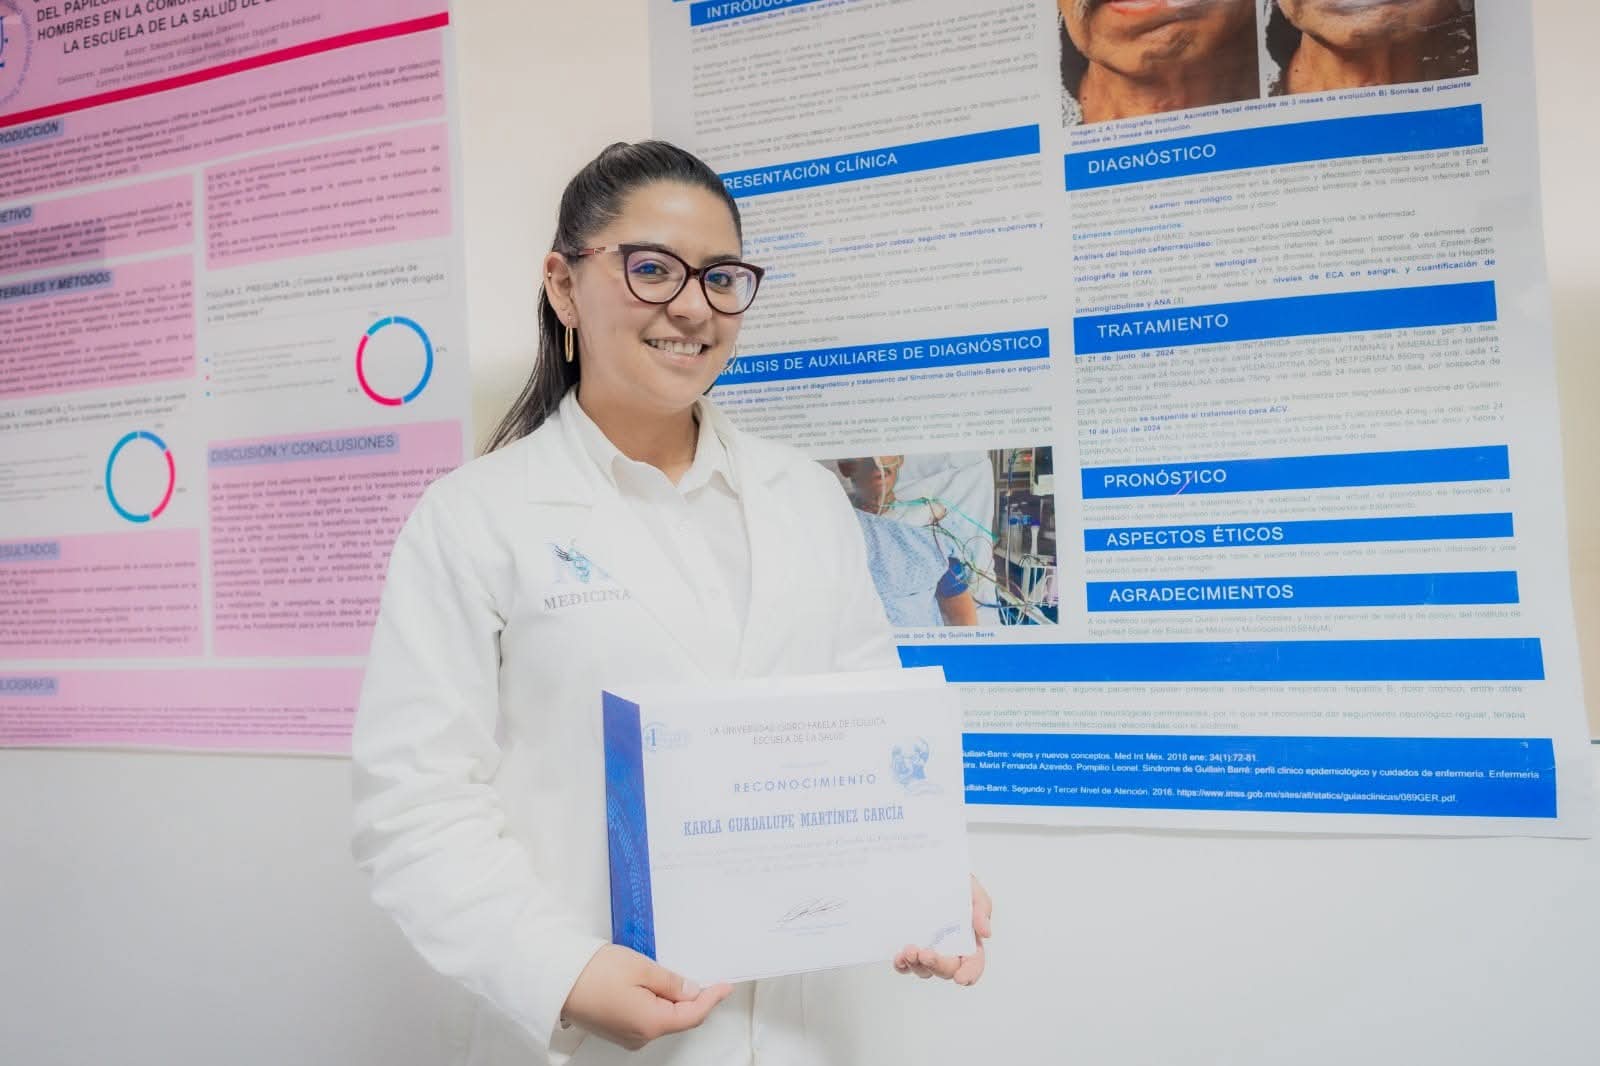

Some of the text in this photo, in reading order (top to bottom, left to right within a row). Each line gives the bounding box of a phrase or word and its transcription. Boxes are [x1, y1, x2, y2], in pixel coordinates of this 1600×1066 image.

[37, 6, 60, 22] DEL
[38, 14, 100, 40] HOMBRES
[104, 8, 121, 24] EN
[125, 4, 142, 18] LA
[64, 40, 79, 54] LA
[83, 24, 144, 49] ESCUELA
[148, 17, 166, 33] DE
[171, 13, 188, 28] LA
[192, 0, 237, 23] SALUD
[1422, 84, 1434, 93] del
[1088, 144, 1216, 174] DIAGNÓSTICO
[722, 152, 898, 190] RESENTACIÓN CLÍNICA
[1274, 274, 1303, 284] niveles
[1309, 272, 1320, 281] de
[1325, 270, 1344, 280] ECA
[1350, 270, 1361, 278] en
[1416, 260, 1478, 272] cuantificación
[1484, 258, 1496, 266] de
[1154, 298, 1172, 306] ANA
[1096, 314, 1229, 338] TRATAMIENTO
[784, 358, 804, 370] DE
[808, 349, 898, 368] AUXILIARES
[903, 346, 924, 360] DE
[929, 336, 1042, 358] DIAGNÓSTICO
[1102, 354, 1112, 362] de
[946, 370, 954, 378] de
[291, 434, 395, 456] CONCLUSIONES
[1104, 468, 1227, 488] PRONÓSTICO
[1106, 525, 1284, 546] ASPECTOS ÉTICOS
[544, 589, 632, 610] MEDICINA
[1109, 584, 1294, 603] AGRADECIMIENTOS
[1012, 752, 1034, 760] viejos
[1034, 752, 1040, 760] y
[1114, 752, 1132, 760] Med
[1134, 752, 1144, 760] Int
[1168, 753, 1188, 761] 2018
[1002, 762, 1038, 770] Fernanda
[1076, 764, 1110, 772] Pompilio
[1194, 766, 1226, 774] Guillain
[1306, 767, 1370, 778] epidemiológico
[1372, 770, 1378, 778] y
[1379, 768, 1419, 777] cuidados
[1422, 769, 1432, 777] de
[734, 774, 876, 793] RECONOCIMIENTO
[1012, 784, 1046, 794] Segundo
[1047, 786, 1052, 794] y
[1054, 786, 1078, 794] Tercer
[1080, 786, 1100, 794] Nivel
[1102, 786, 1112, 794] de
[684, 804, 904, 836] KARLA GUADALUPE MARTÍNEZ GARCÍA
